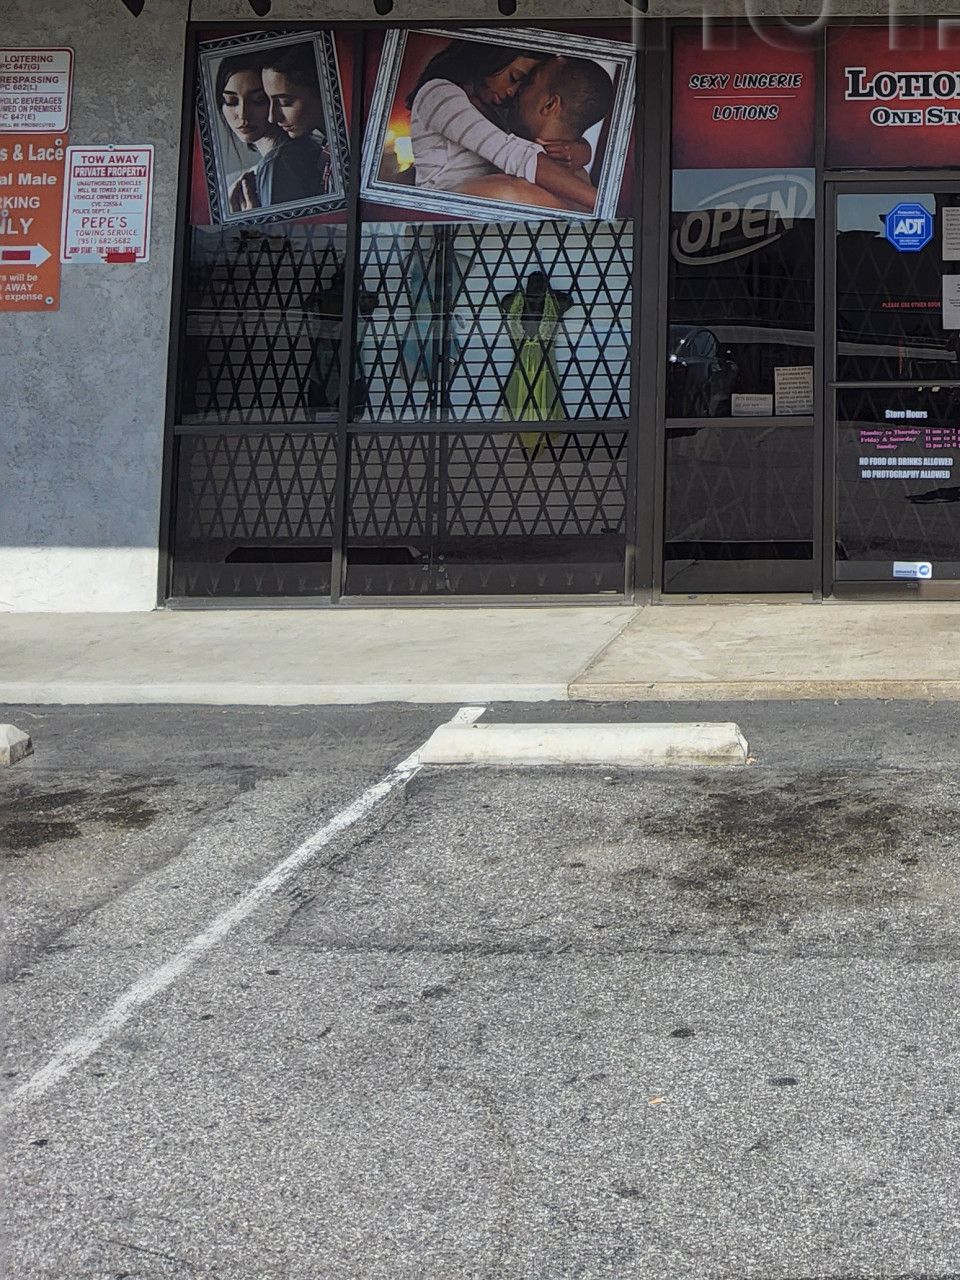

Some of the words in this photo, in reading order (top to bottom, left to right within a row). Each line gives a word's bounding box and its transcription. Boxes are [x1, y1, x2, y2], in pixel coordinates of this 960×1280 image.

[689, 73, 730, 89] SEXY
[733, 73, 803, 89] LINGERIE
[712, 105, 779, 120] LOTIONS
[871, 106, 923, 126] ONE
[12, 144, 23, 161] &
[28, 144, 64, 161] Lace
[81, 156, 105, 164] TOW
[108, 156, 139, 164] AWAY
[75, 166, 106, 177] PRIVATE
[107, 166, 146, 177] PROPERTY
[18, 173, 57, 185] Male
[82, 216, 128, 229] PEPE'S
[680, 186, 798, 254] OPEN
[895, 219, 925, 234] ADT
[10, 273, 25, 281] will
[27, 273, 38, 281] be
[5, 293, 43, 301] expense
[885, 410, 905, 419] Store
[906, 410, 928, 419] Hours
[859, 457, 869, 466] NO
[870, 457, 887, 466] FOOD
[888, 457, 897, 466] OR
[898, 457, 922, 466] DRINKS
[923, 457, 953, 466] ALLOWED
[862, 470, 872, 479] NO
[872, 470, 920, 479] PHOTOGRAPHY
[920, 470, 951, 479] ALLOWED
